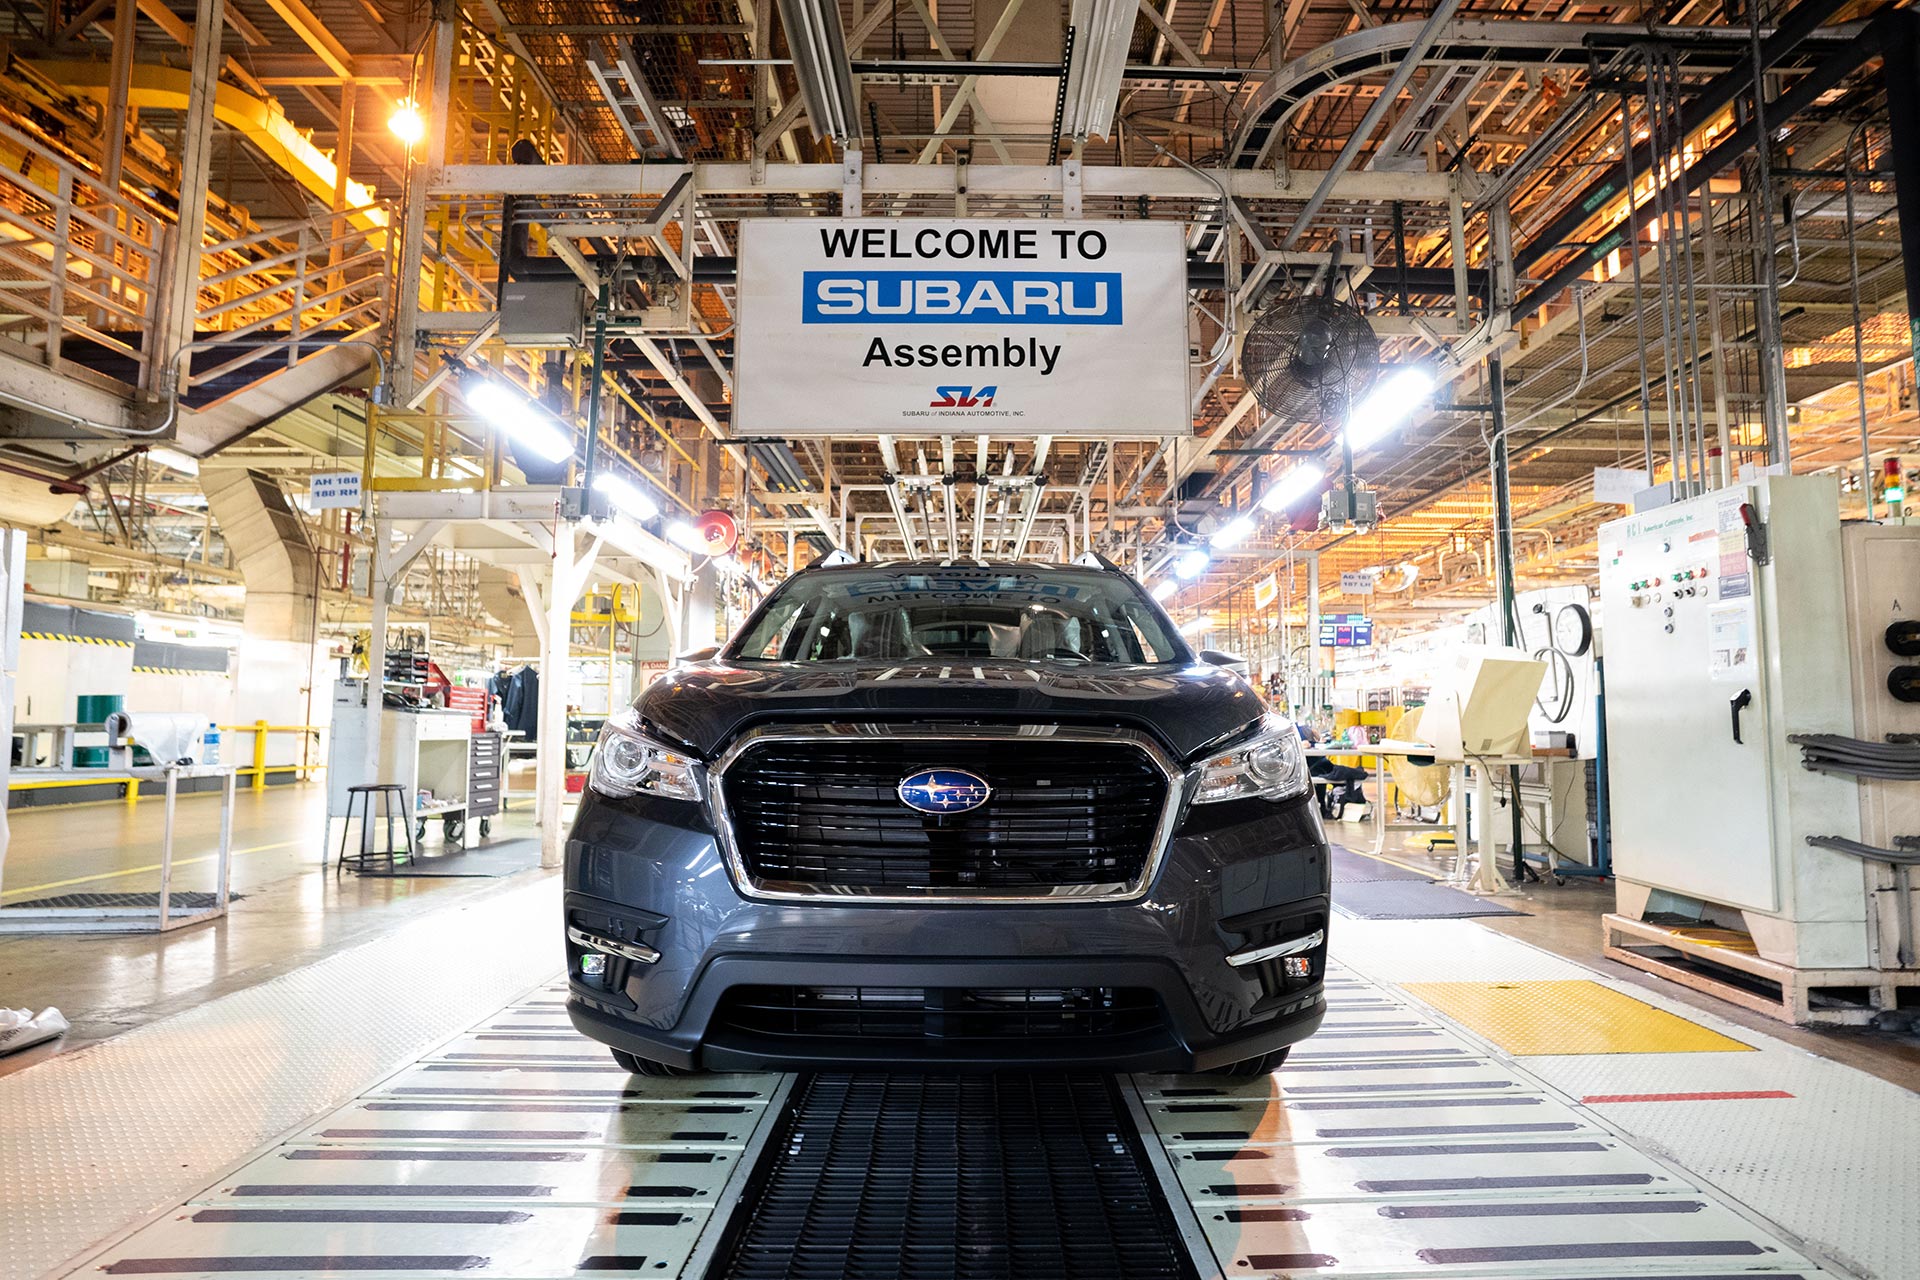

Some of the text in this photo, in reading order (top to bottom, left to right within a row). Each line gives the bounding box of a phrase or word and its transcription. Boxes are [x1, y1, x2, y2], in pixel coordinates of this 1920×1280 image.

[820, 229, 1107, 259] WELCOME TO
[817, 279, 1108, 316] SUBARU
[862, 337, 1062, 375] Assembly
[967, 410, 1012, 418] AUTOMOTIVE,
[315, 477, 358, 486] AH 188
[314, 488, 358, 498] 188 RH
[1892, 599, 1901, 611] A
